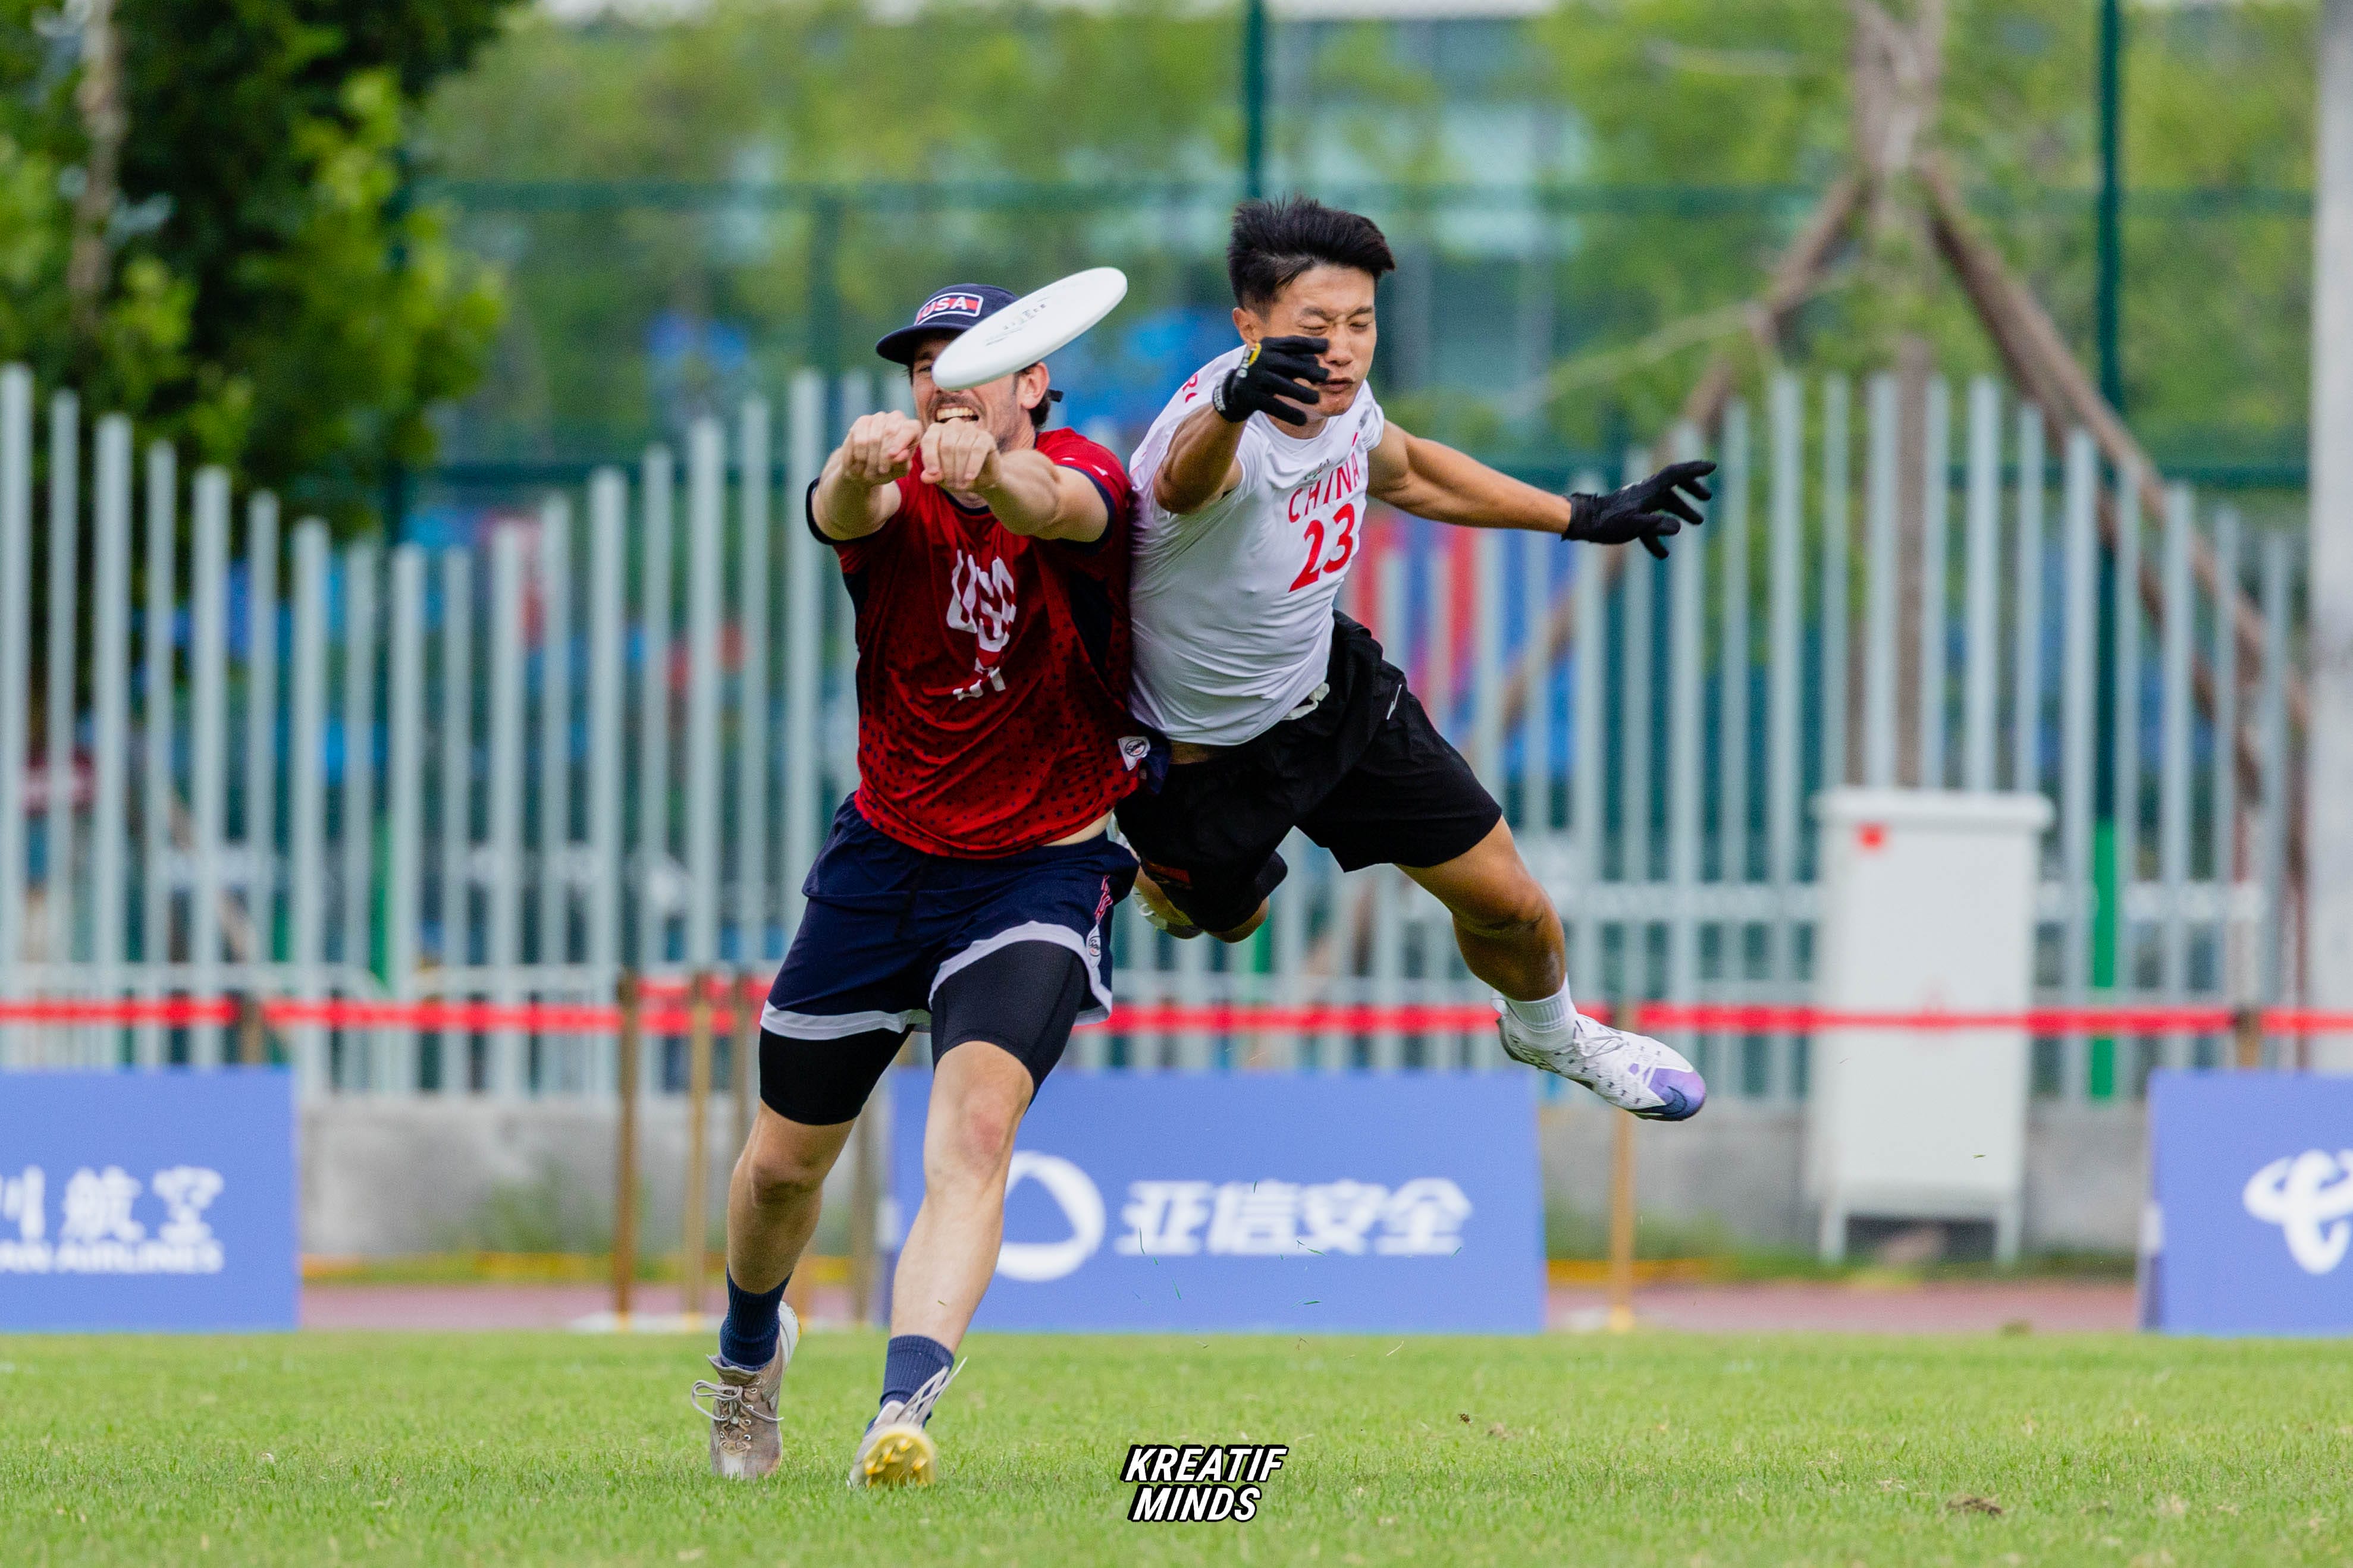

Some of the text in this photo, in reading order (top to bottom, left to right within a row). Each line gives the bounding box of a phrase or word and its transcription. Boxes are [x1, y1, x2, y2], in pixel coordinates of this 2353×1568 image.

[921, 297, 968, 318] USA
[1288, 452, 1360, 523] CHINA
[1288, 503, 1355, 593] 23
[1113, 1179, 1473, 1255] 亚信安全
